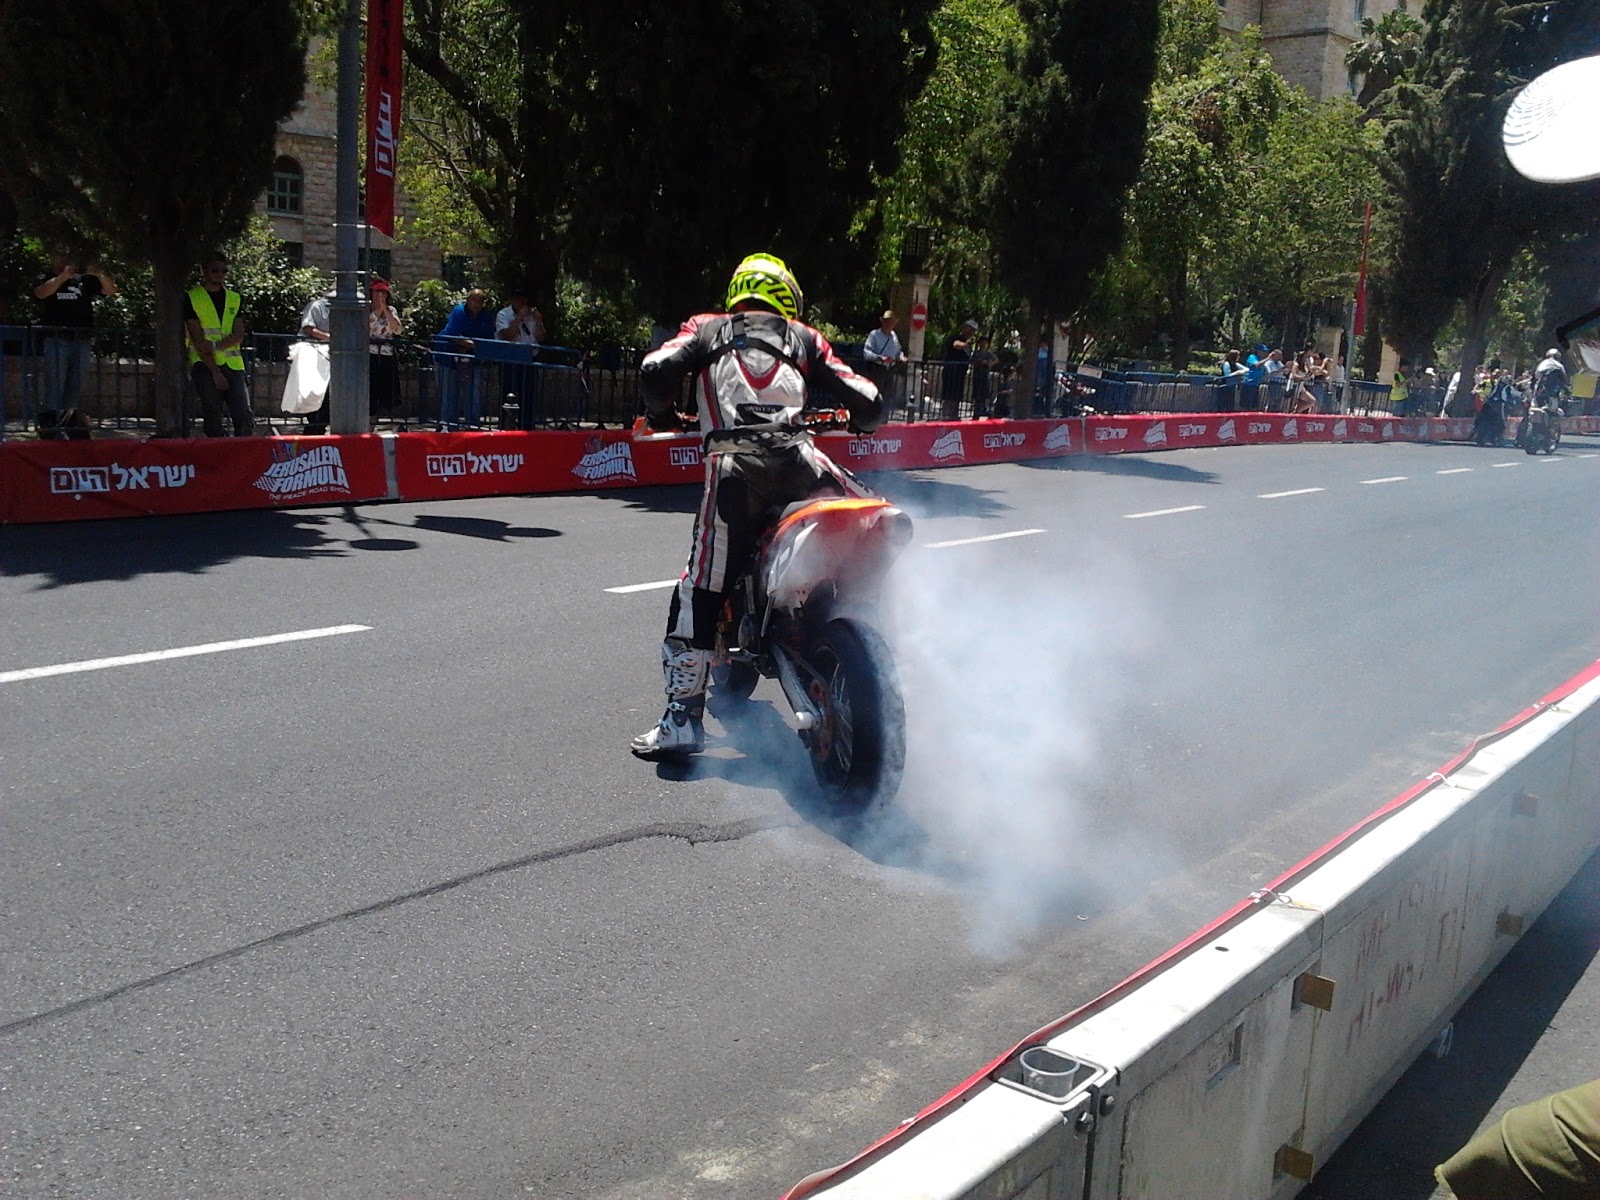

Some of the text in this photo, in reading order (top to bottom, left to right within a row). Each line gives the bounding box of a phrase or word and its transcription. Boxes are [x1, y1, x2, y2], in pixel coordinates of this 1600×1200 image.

[670, 446, 699, 470] היום
[870, 437, 902, 454] ישראל
[263, 445, 343, 478] JERUSALEM
[426, 450, 525, 482] ישראל היום
[50, 462, 195, 500] ישראל היום
[270, 465, 350, 493] FORMULA
[308, 487, 328, 495] ROAD
